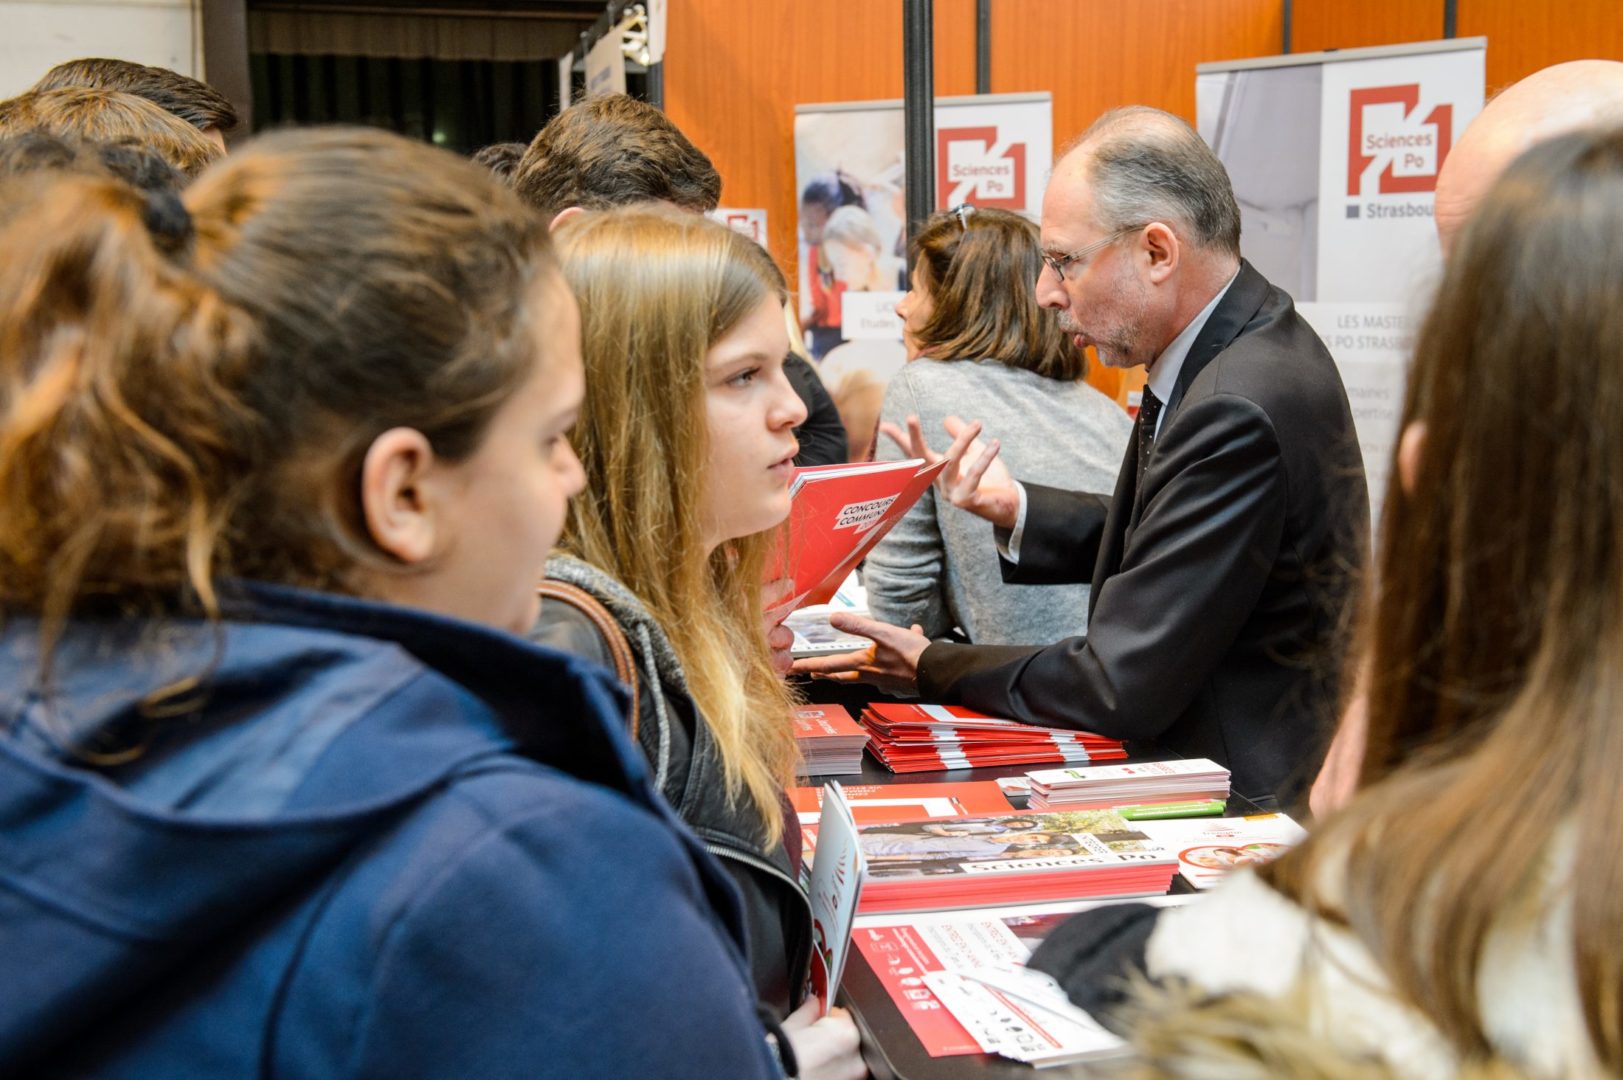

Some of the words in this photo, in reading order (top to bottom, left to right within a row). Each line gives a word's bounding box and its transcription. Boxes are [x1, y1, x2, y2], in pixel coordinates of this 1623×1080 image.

[1366, 133, 1432, 150] Sciences
[1404, 153, 1424, 169] Po
[952, 164, 1010, 177] Sciences
[986, 180, 1004, 192] Po
[1366, 202, 1434, 219] Strasbou
[1337, 314, 1360, 329] LES
[1363, 314, 1407, 329] MASTE
[1335, 334, 1354, 349] PO
[971, 857, 1104, 872] Sciences
[1117, 853, 1158, 862] Po
